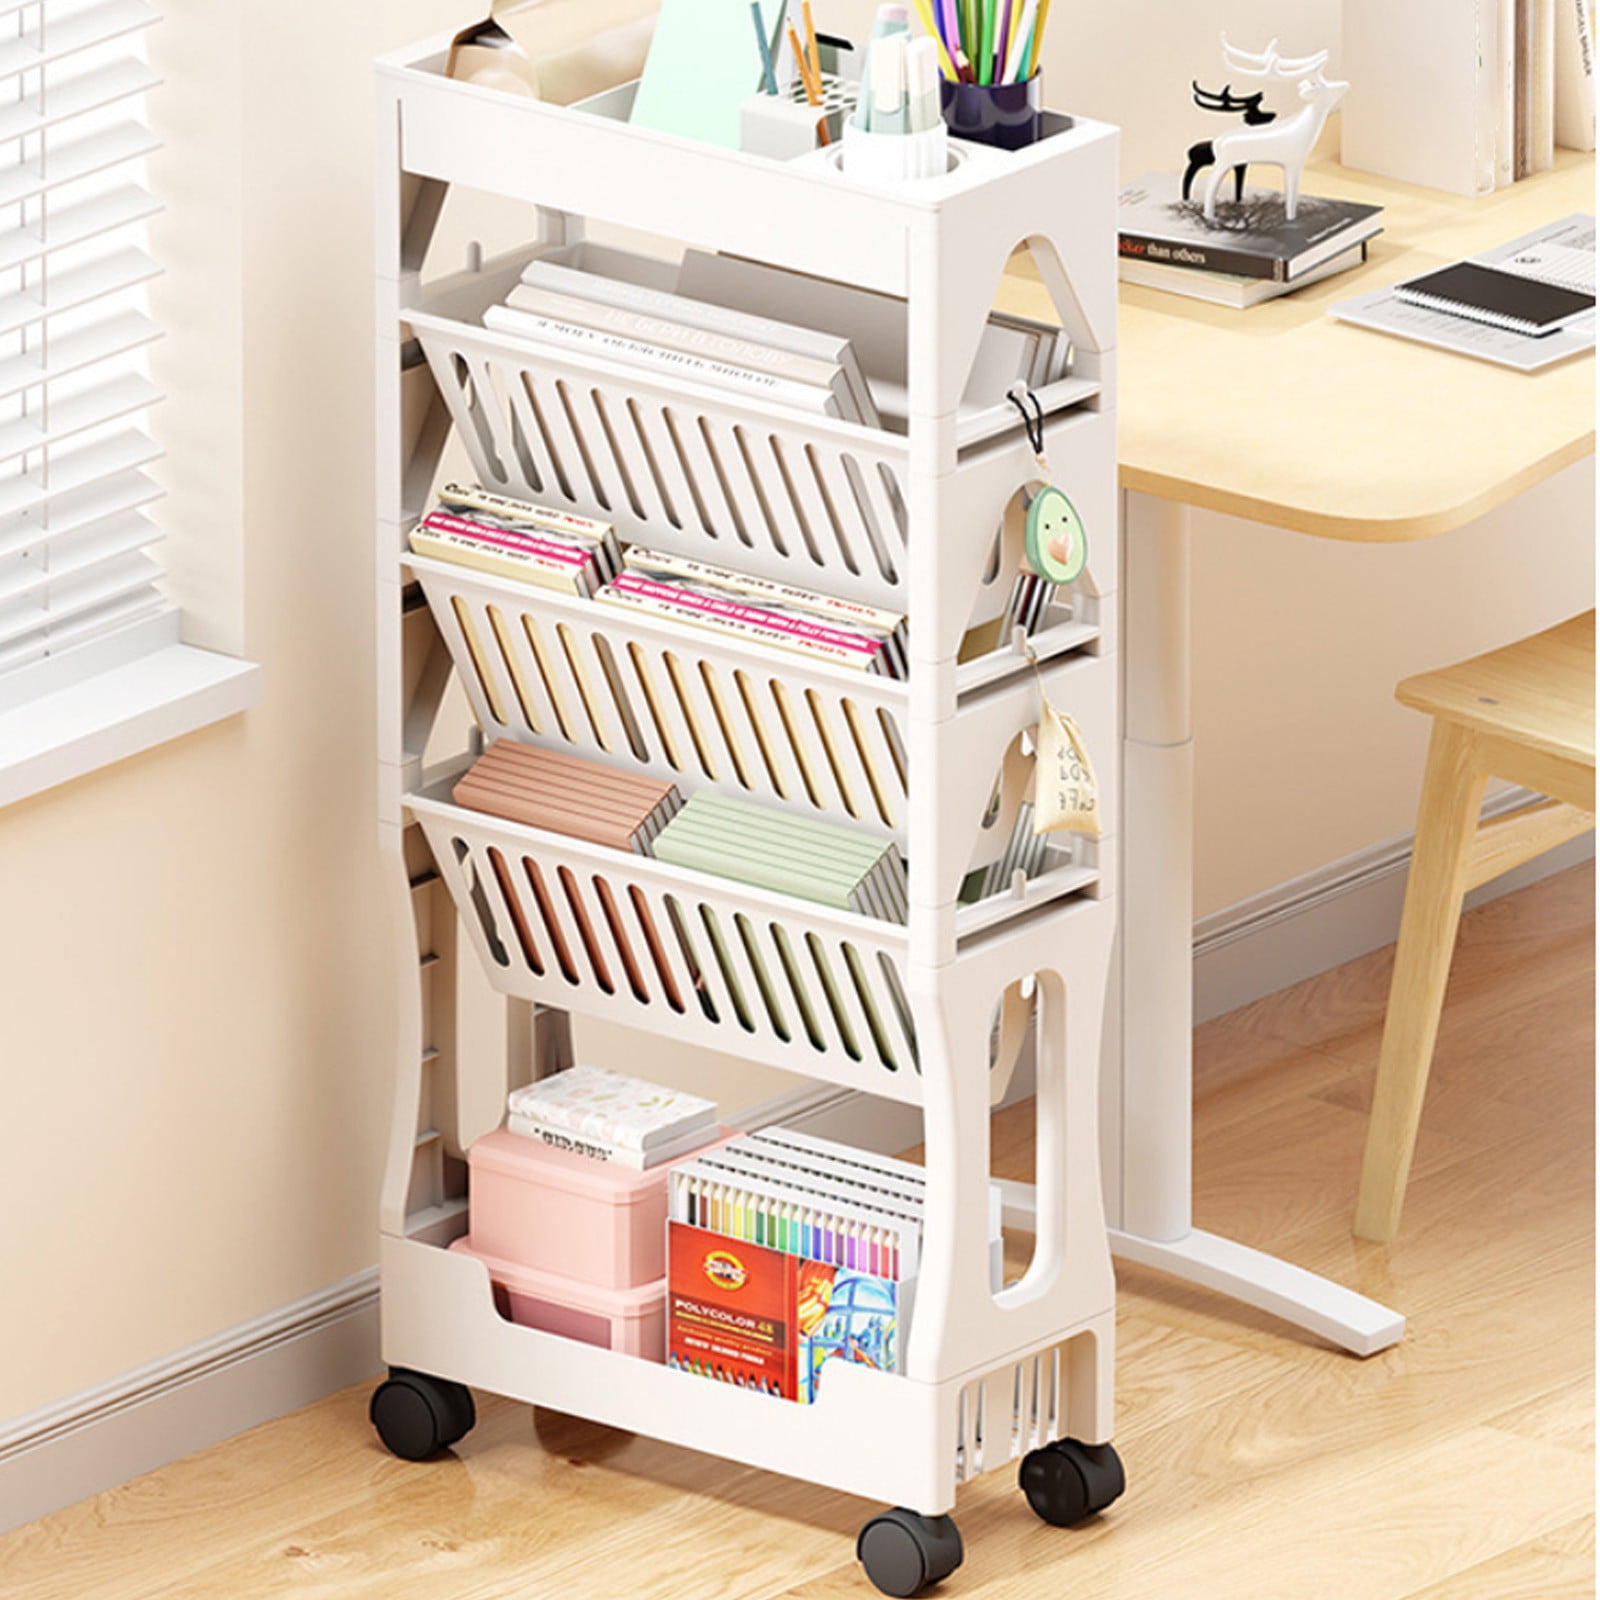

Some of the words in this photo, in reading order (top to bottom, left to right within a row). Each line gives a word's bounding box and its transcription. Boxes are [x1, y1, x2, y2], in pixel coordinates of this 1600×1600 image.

[1147, 242, 1170, 259] than
[1172, 248, 1206, 264] others
[675, 1299, 756, 1329] POLYCOLOR
